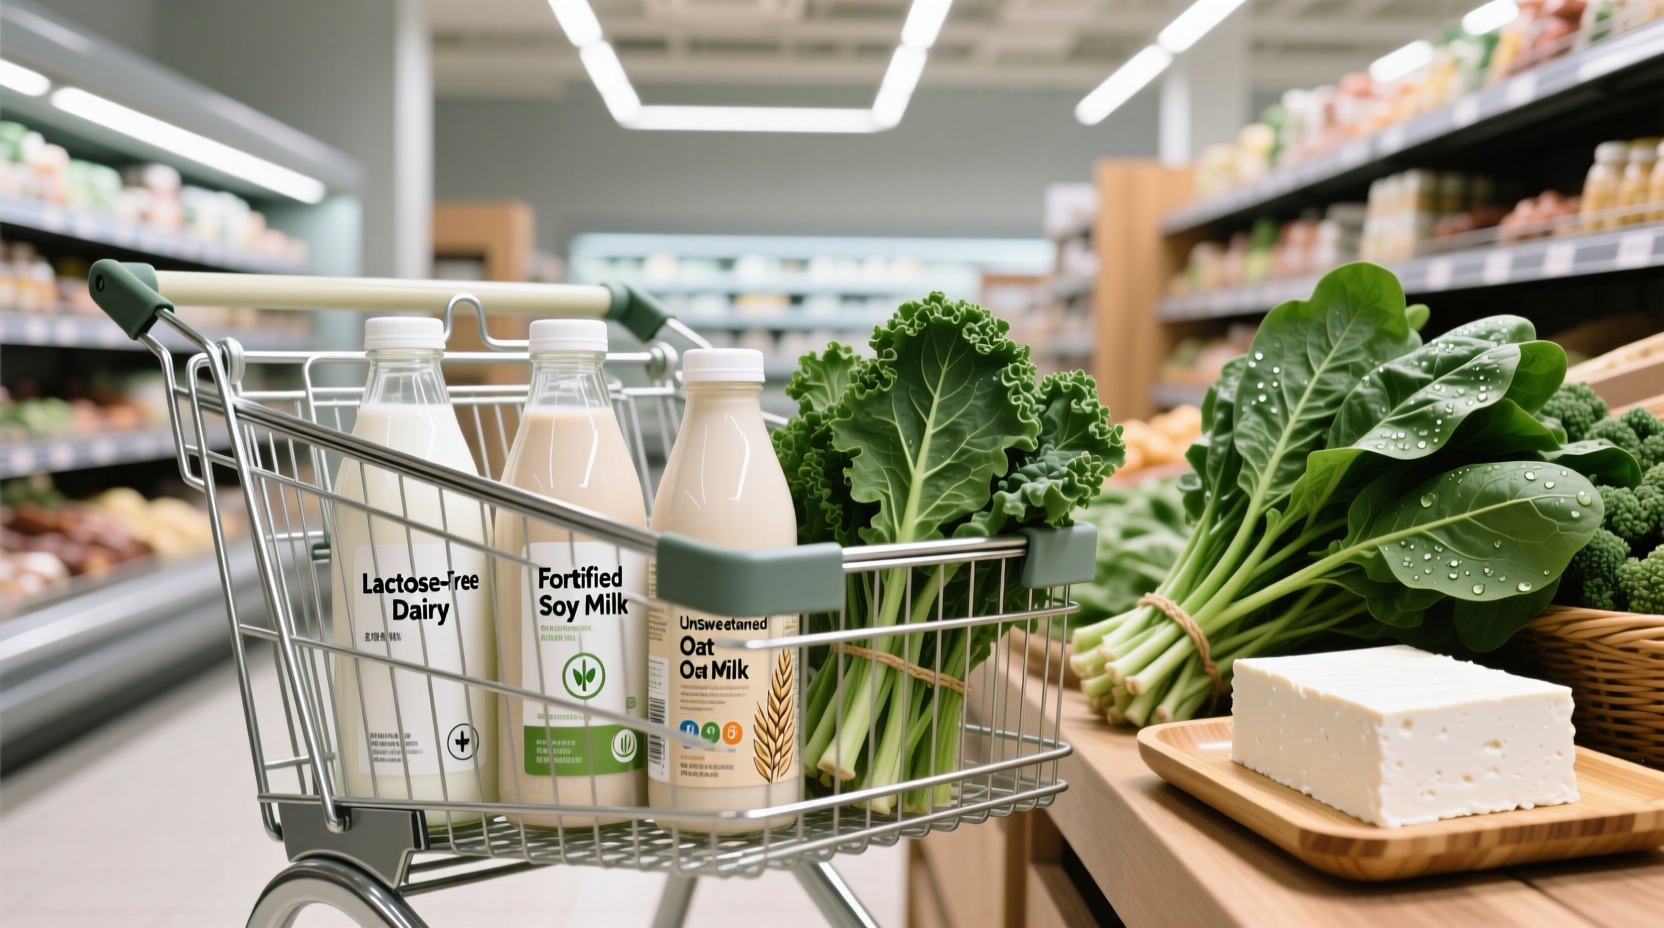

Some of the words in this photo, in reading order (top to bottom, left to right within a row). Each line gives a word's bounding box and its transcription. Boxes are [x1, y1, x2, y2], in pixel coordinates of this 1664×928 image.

[539, 566, 622, 589] Fortified
[392, 598, 449, 626] Dairy
[539, 594, 579, 622] Soy
[585, 592, 628, 615] Milk
[680, 636, 714, 656] Oat
[712, 659, 749, 680] Milk
